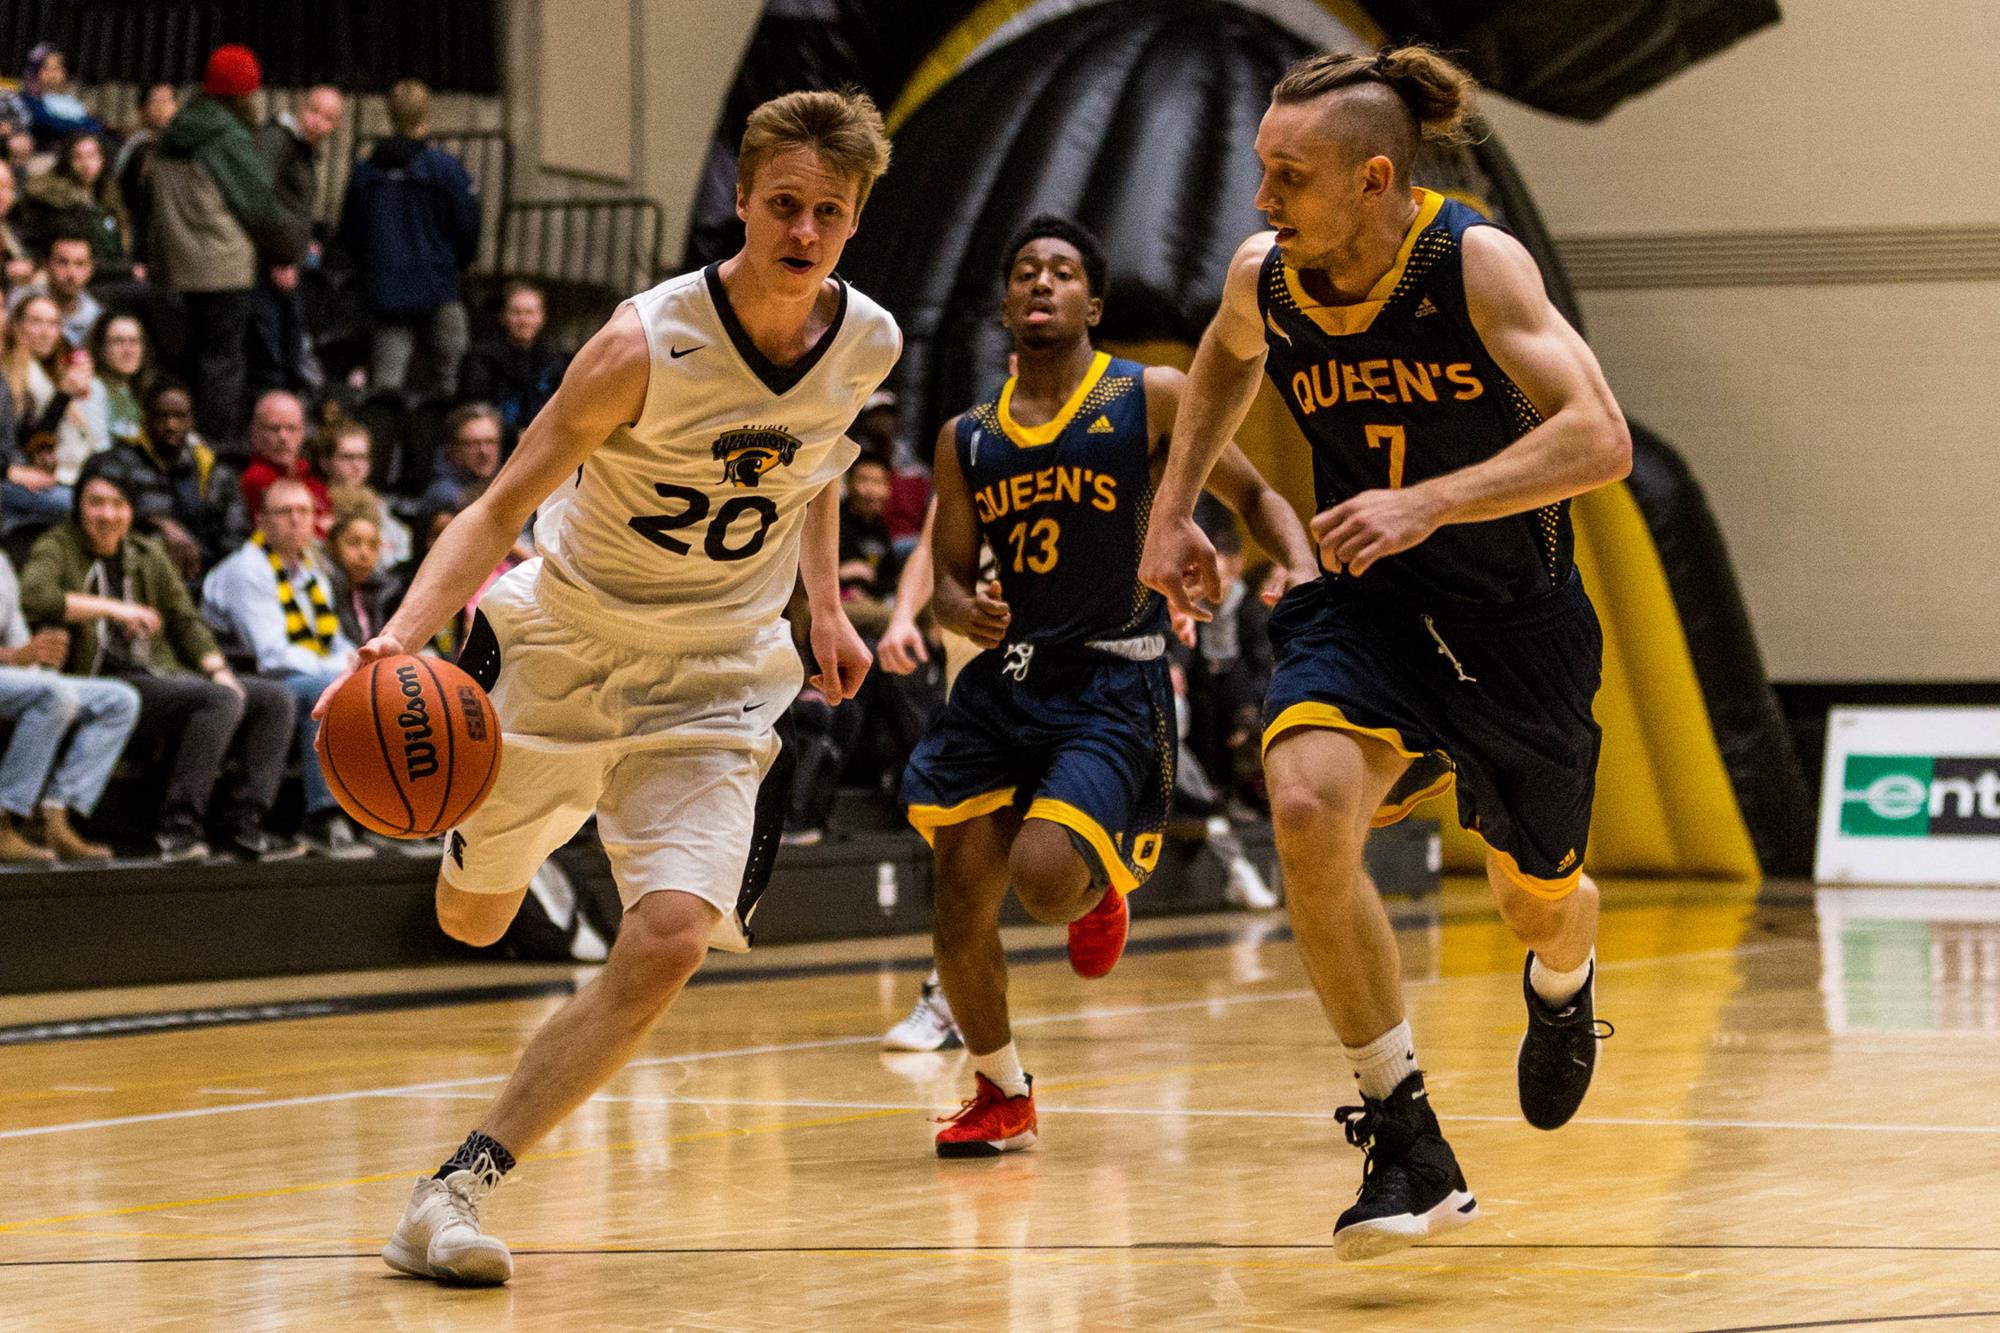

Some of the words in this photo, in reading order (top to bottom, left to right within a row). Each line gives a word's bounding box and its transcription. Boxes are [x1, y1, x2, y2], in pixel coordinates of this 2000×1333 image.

[1292, 358, 1484, 415] QUEEN'S
[1364, 425, 1406, 489] 7
[627, 482, 779, 561] 20
[975, 465, 1117, 524] QUEEN'S
[1008, 517, 1061, 574] 13
[396, 665, 439, 783] Wilson
